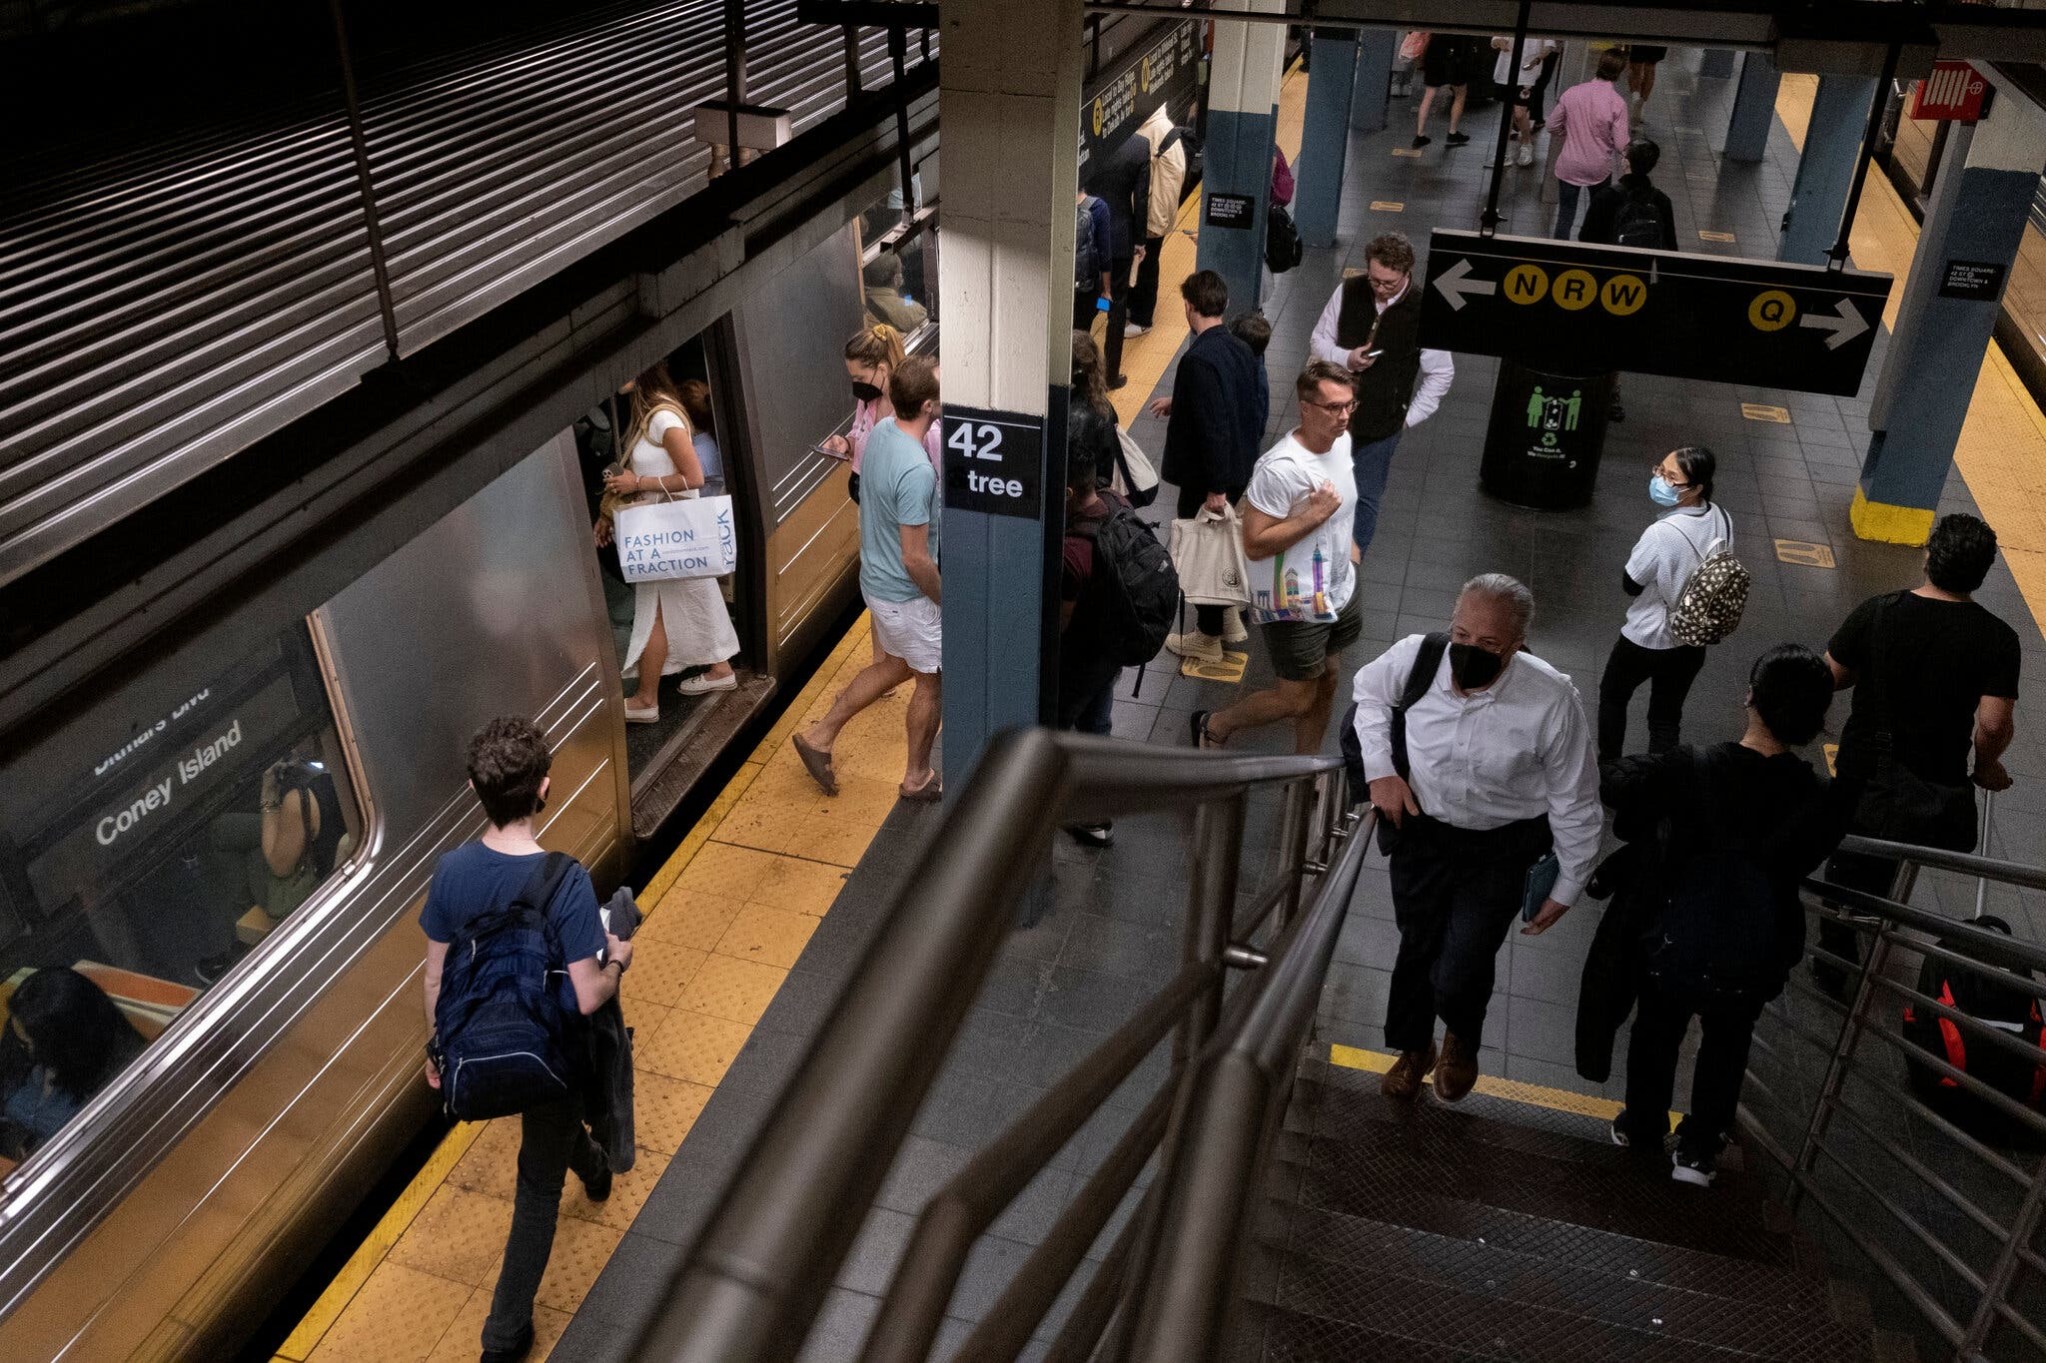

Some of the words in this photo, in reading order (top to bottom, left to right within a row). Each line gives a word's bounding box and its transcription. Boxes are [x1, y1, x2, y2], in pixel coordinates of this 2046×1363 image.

[948, 422, 1003, 462] 42
[967, 470, 1023, 498] tree
[624, 529, 695, 548] FASHION
[626, 549, 643, 563] AT
[651, 548, 661, 559] A
[628, 556, 708, 575] FRACTION
[96, 777, 171, 845] Coney
[177, 719, 242, 785] Island
